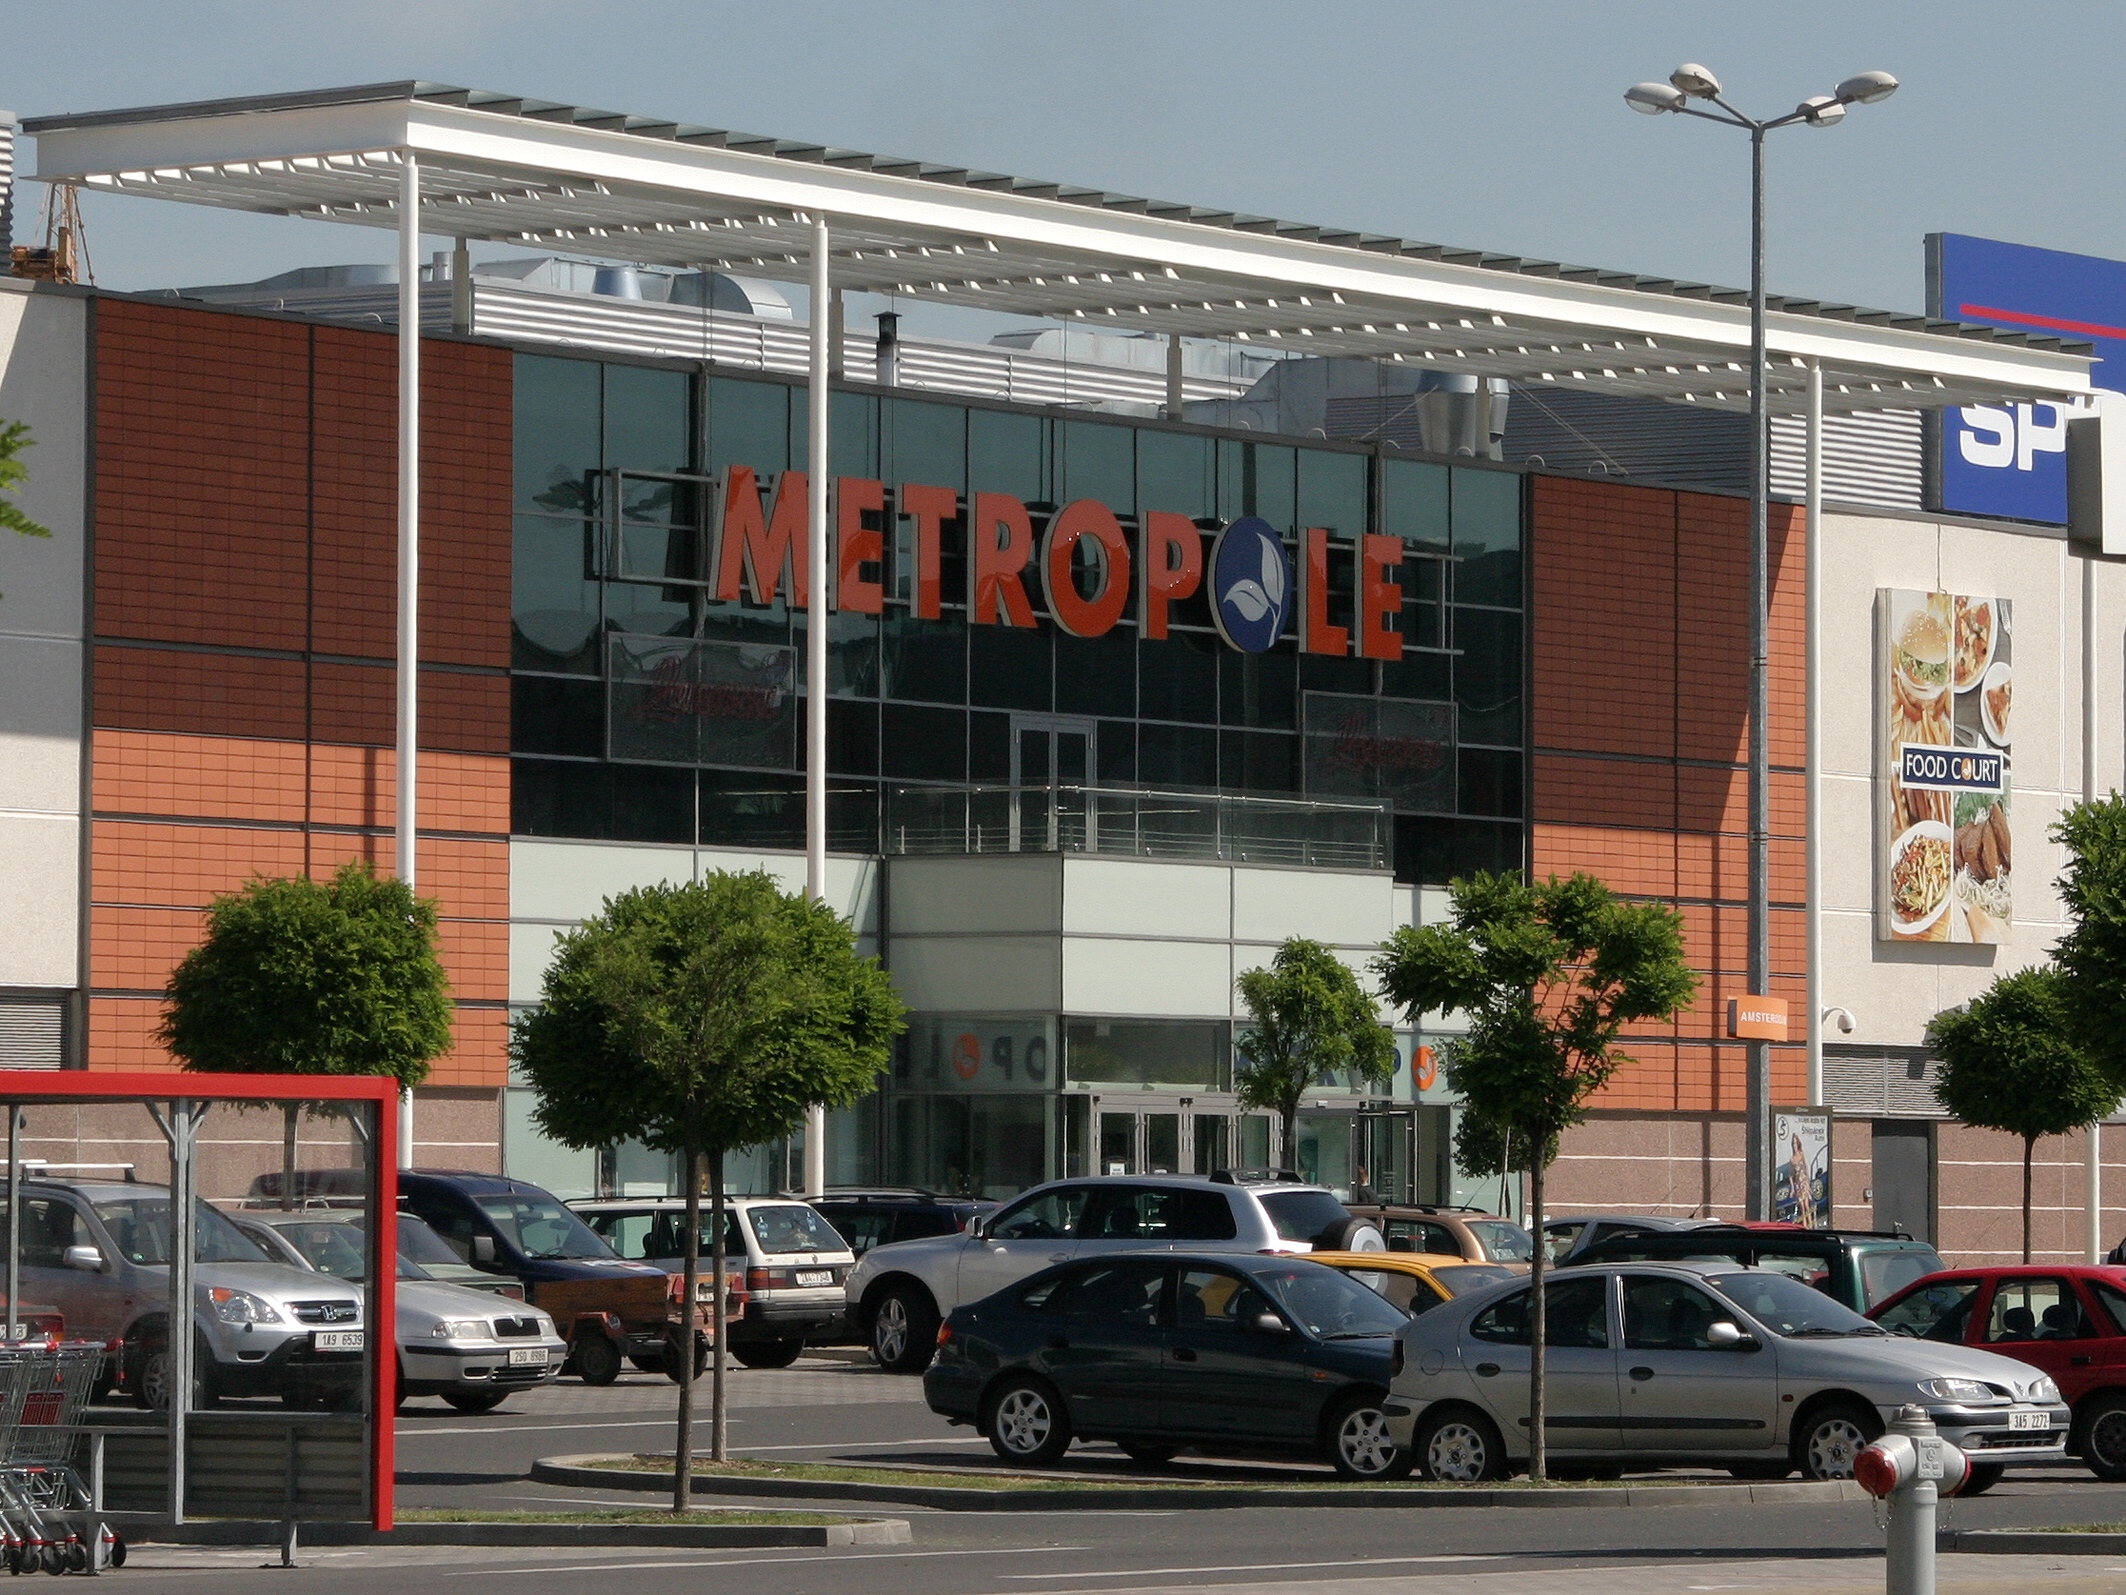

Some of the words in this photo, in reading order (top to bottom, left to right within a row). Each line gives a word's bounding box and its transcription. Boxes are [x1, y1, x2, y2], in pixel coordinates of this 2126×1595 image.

[1960, 396, 2090, 471] SP
[708, 464, 1403, 661] METROPOLE
[1906, 753, 1947, 779] FOOD
[1951, 757, 1998, 782] COURT
[1740, 1011, 1787, 1027] AMSTER
[342, 1334, 363, 1346] 6539
